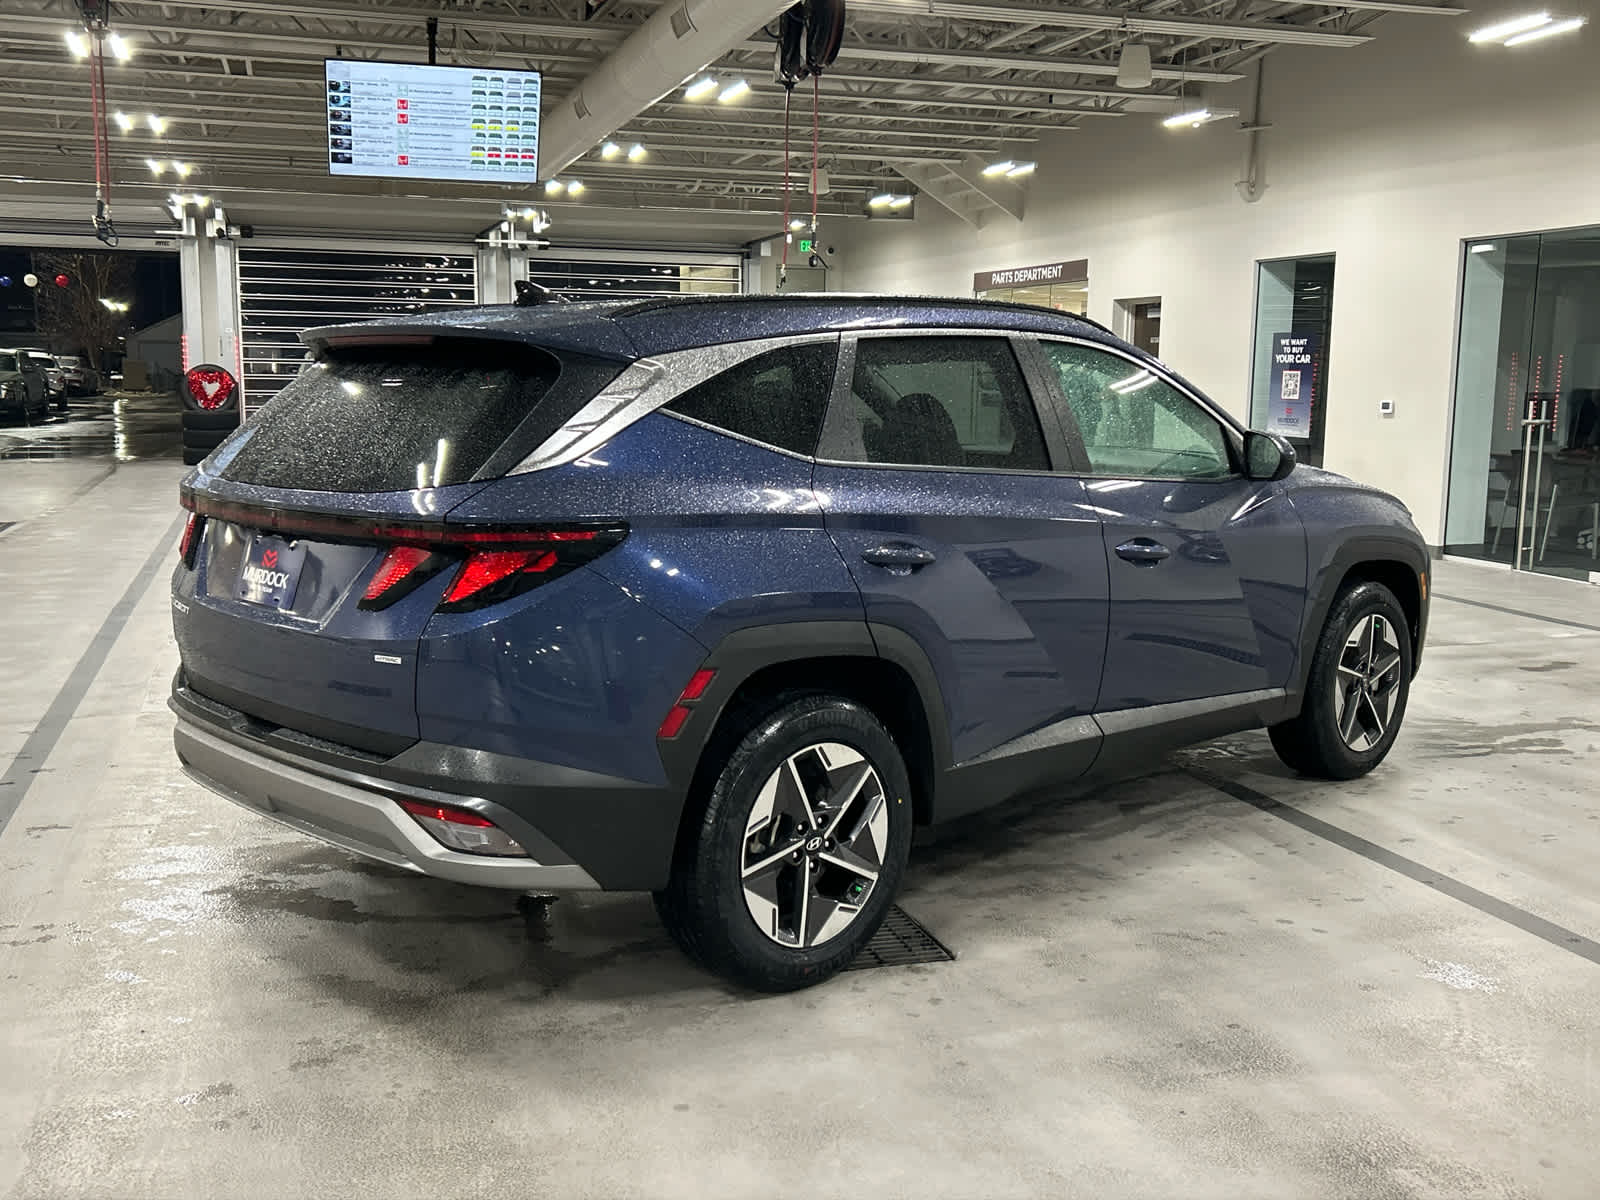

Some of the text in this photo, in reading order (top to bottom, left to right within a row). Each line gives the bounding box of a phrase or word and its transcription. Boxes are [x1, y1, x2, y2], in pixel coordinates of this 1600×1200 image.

[991, 265, 1063, 285] PARTS DEPARTMENT
[1280, 338, 1308, 346] WE WANT
[1283, 346, 1305, 354] TO BUY
[1275, 354, 1311, 364] YOUR CAR
[242, 566, 289, 590] MURDOCK
